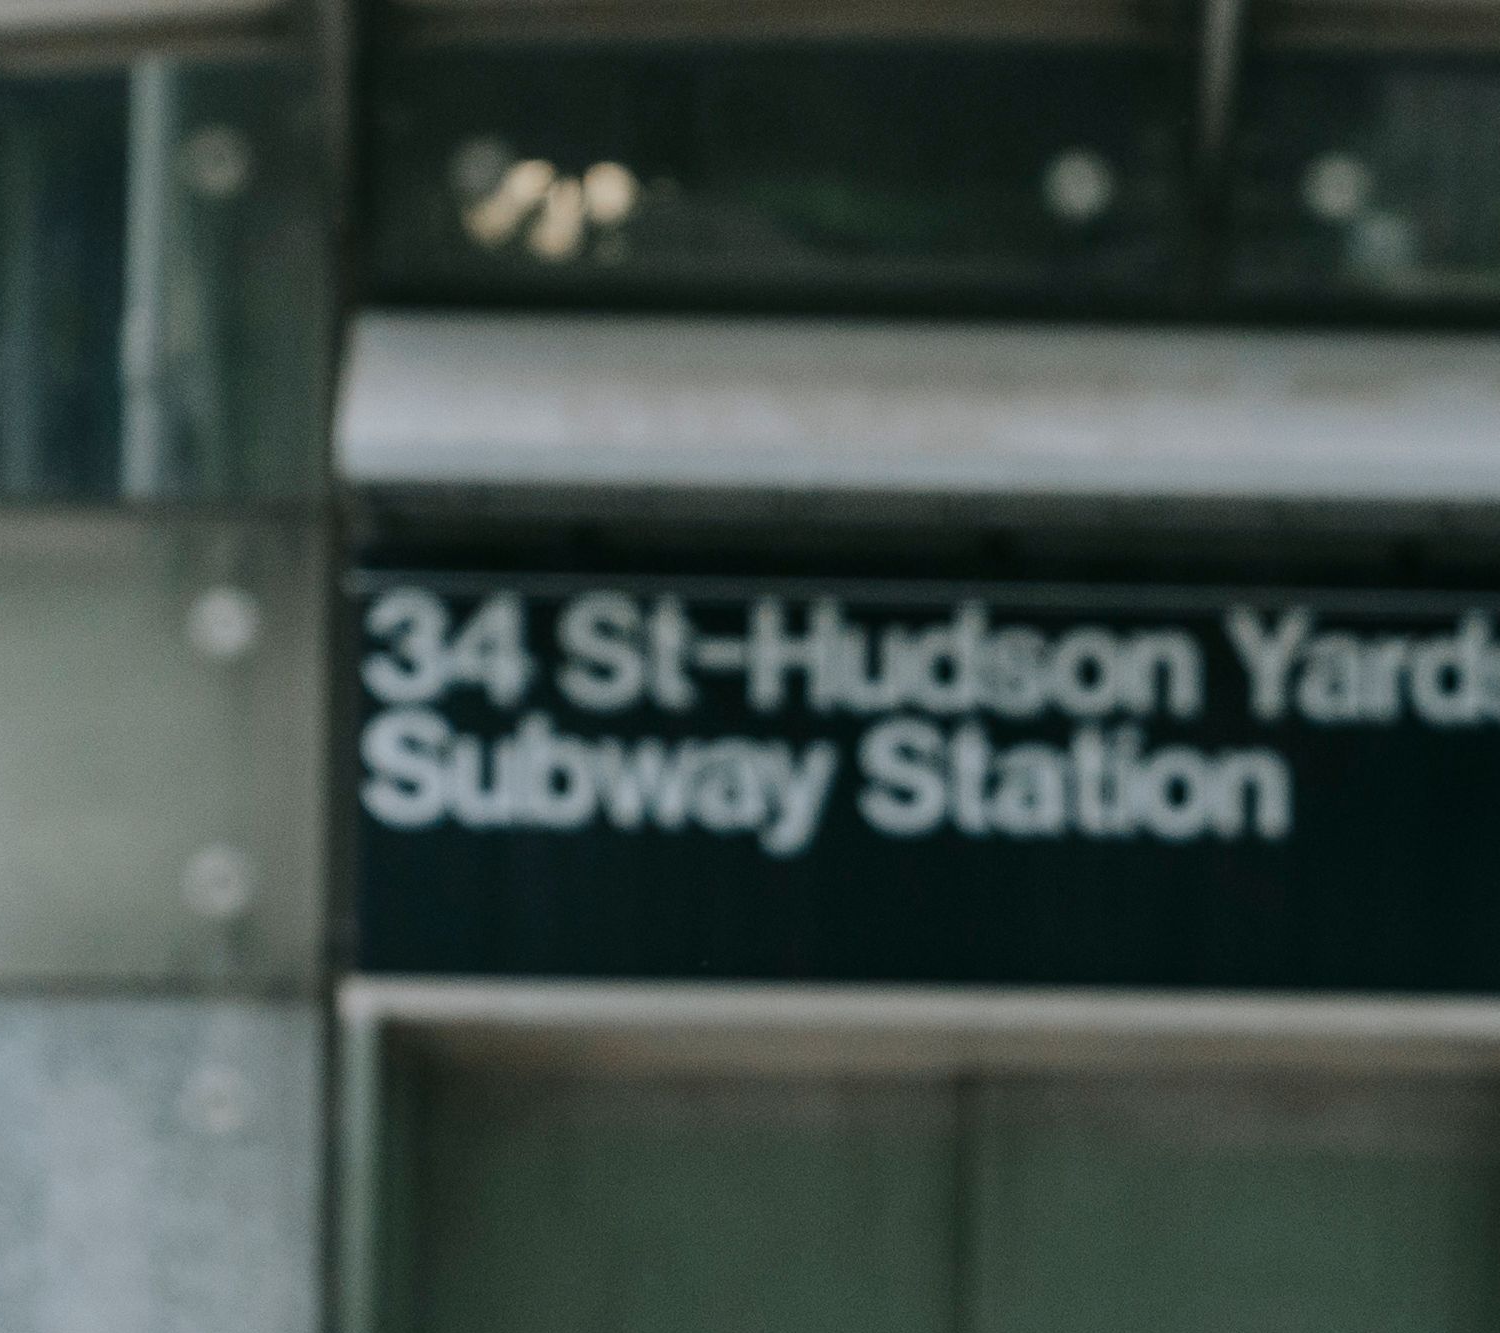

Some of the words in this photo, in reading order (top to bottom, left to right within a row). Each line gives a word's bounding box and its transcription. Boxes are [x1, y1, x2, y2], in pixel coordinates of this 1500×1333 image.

[363, 595, 526, 705] 34
[558, 596, 1203, 718] St-Hudson
[361, 708, 837, 856] Subway
[858, 718, 1292, 839] Station
